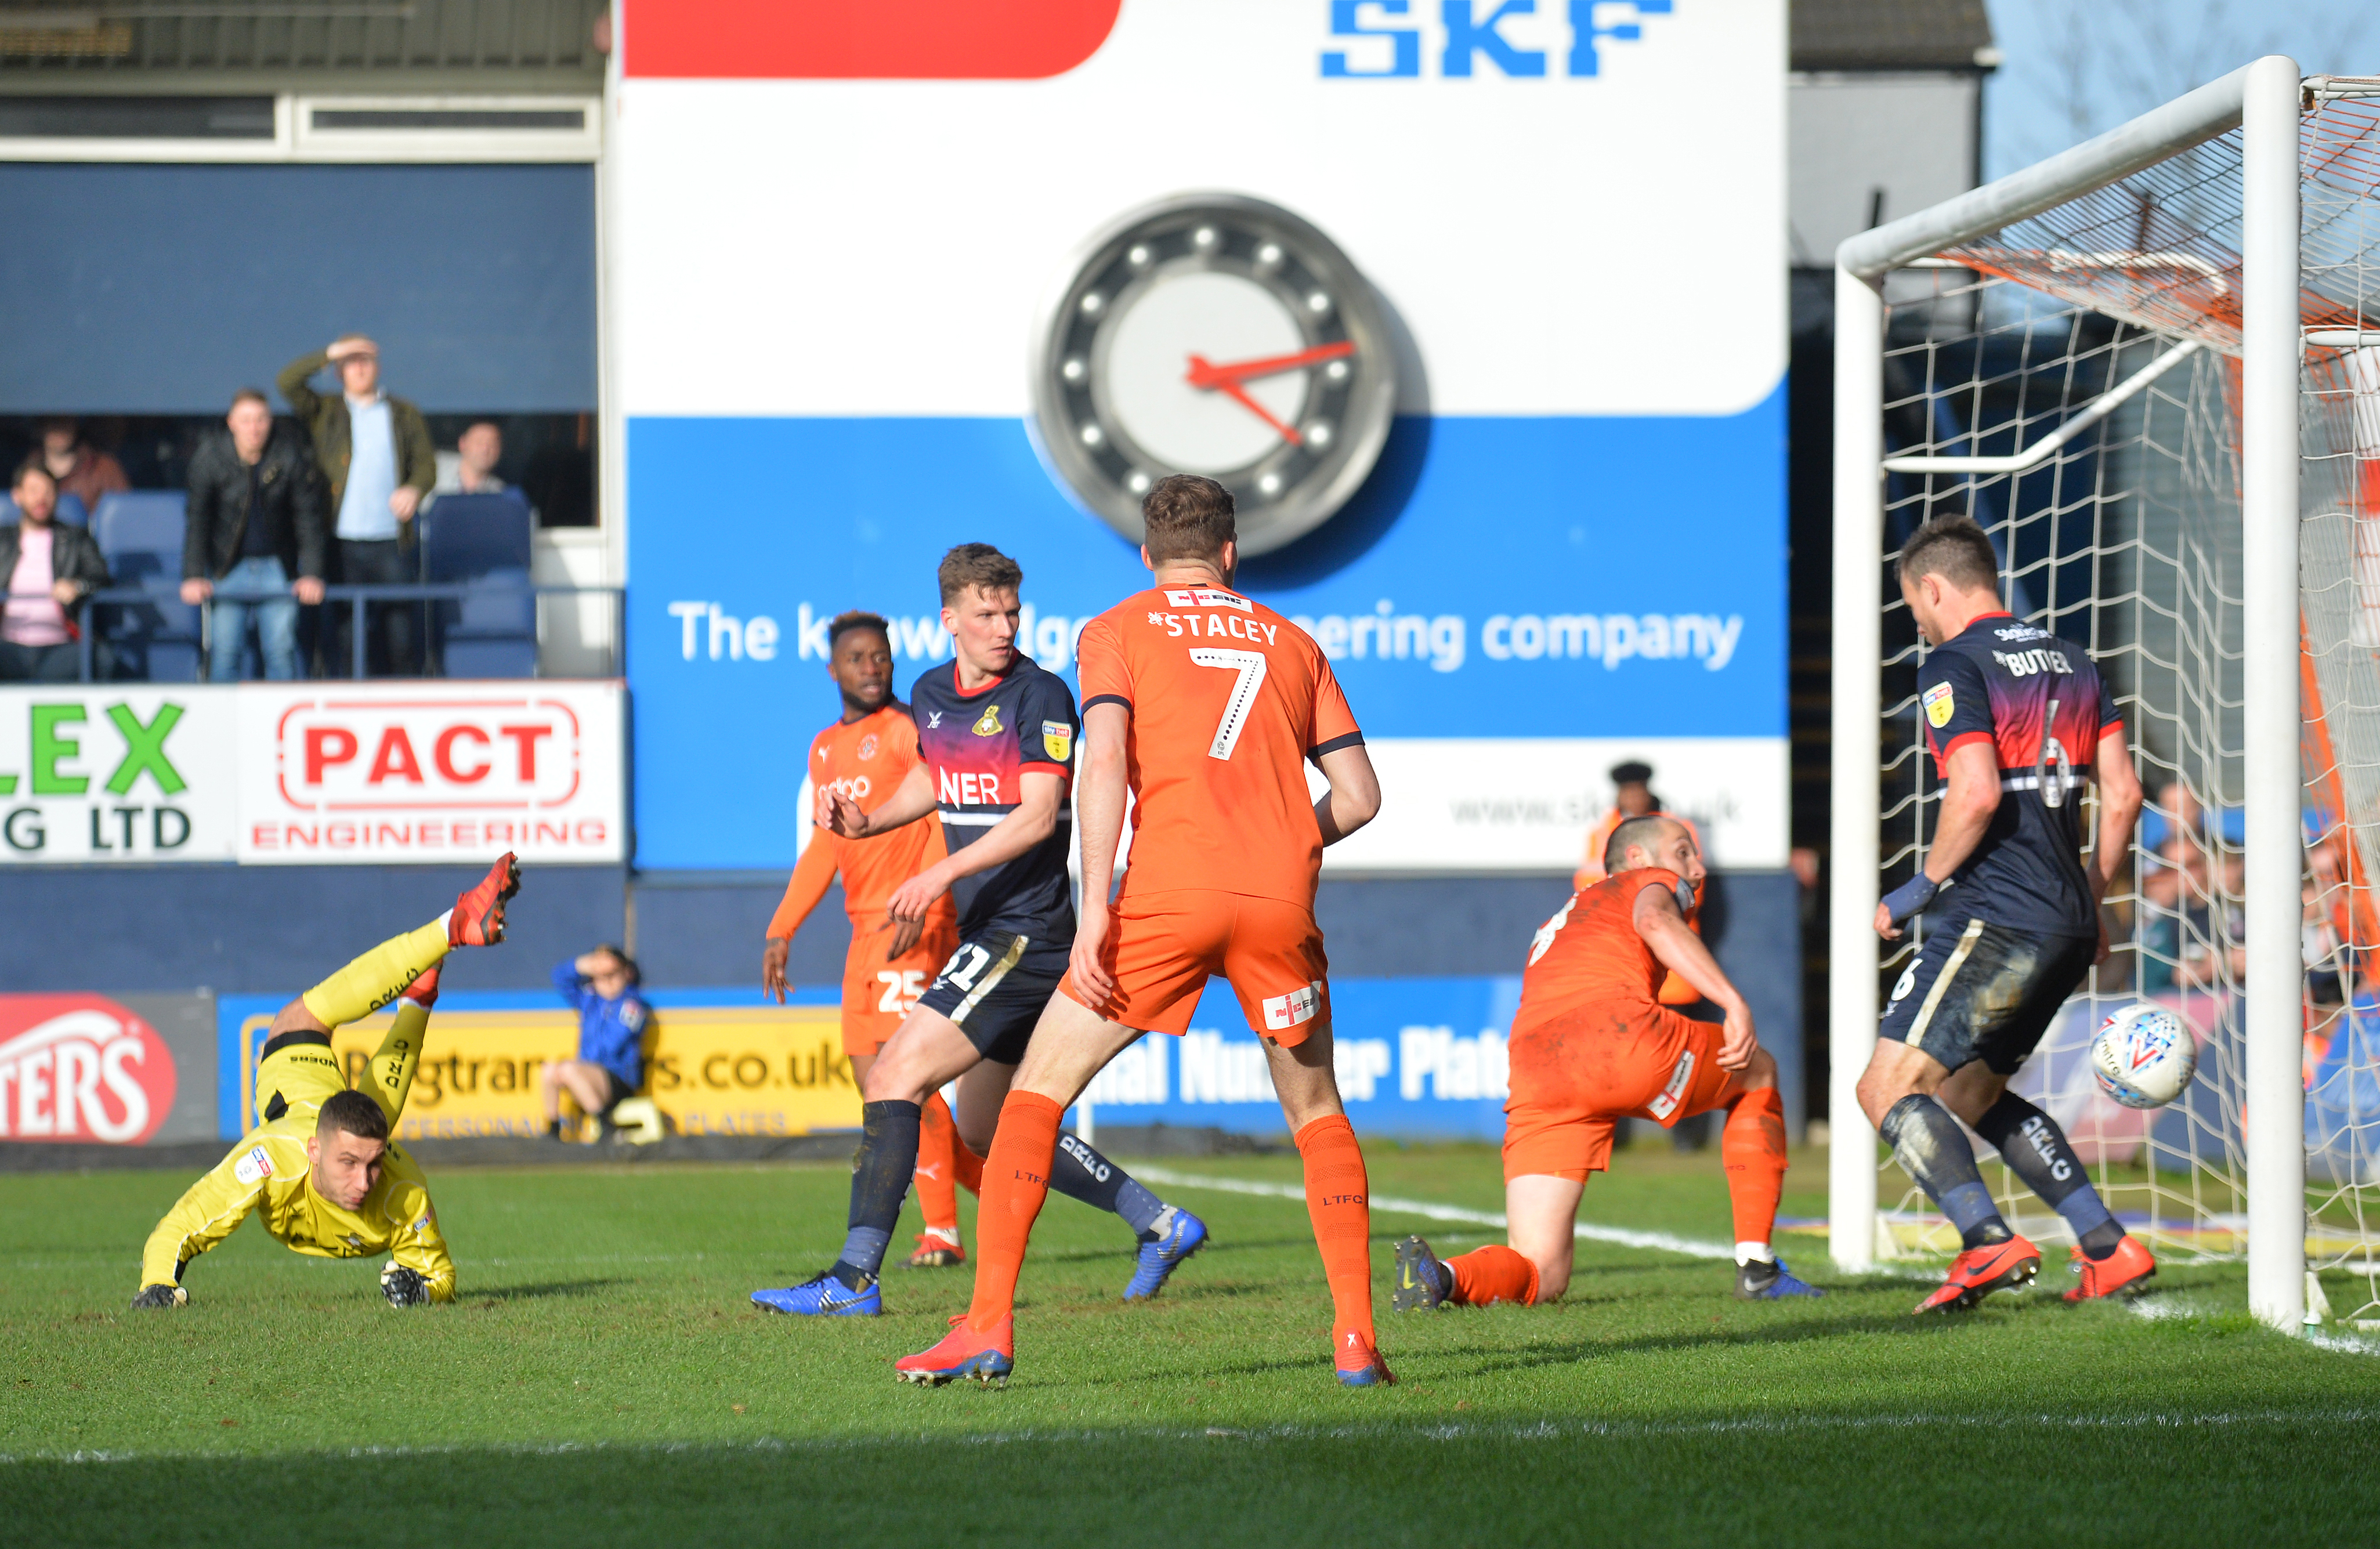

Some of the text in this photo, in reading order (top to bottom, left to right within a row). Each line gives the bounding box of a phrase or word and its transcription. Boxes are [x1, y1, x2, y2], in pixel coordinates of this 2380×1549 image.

[1321, 0, 1672, 77] SKF
[667, 601, 780, 660] The
[1482, 612, 1743, 671] company
[1166, 613, 1277, 646] STACEY
[1188, 647, 1267, 761] 7
[0, 703, 188, 795] EX
[303, 725, 553, 785] PACT
[937, 766, 1000, 811] NER
[5, 809, 191, 850] G LTD
[252, 821, 606, 849] ENGINEERING
[877, 969, 927, 1013] 25
[1890, 957, 1923, 1001] 6
[1399, 1027, 1510, 1101] Plat
[1059, 1135, 1111, 1183] DRFC
[2020, 1116, 2072, 1181] DRFC
[1323, 1195, 1363, 1206] LTFC
